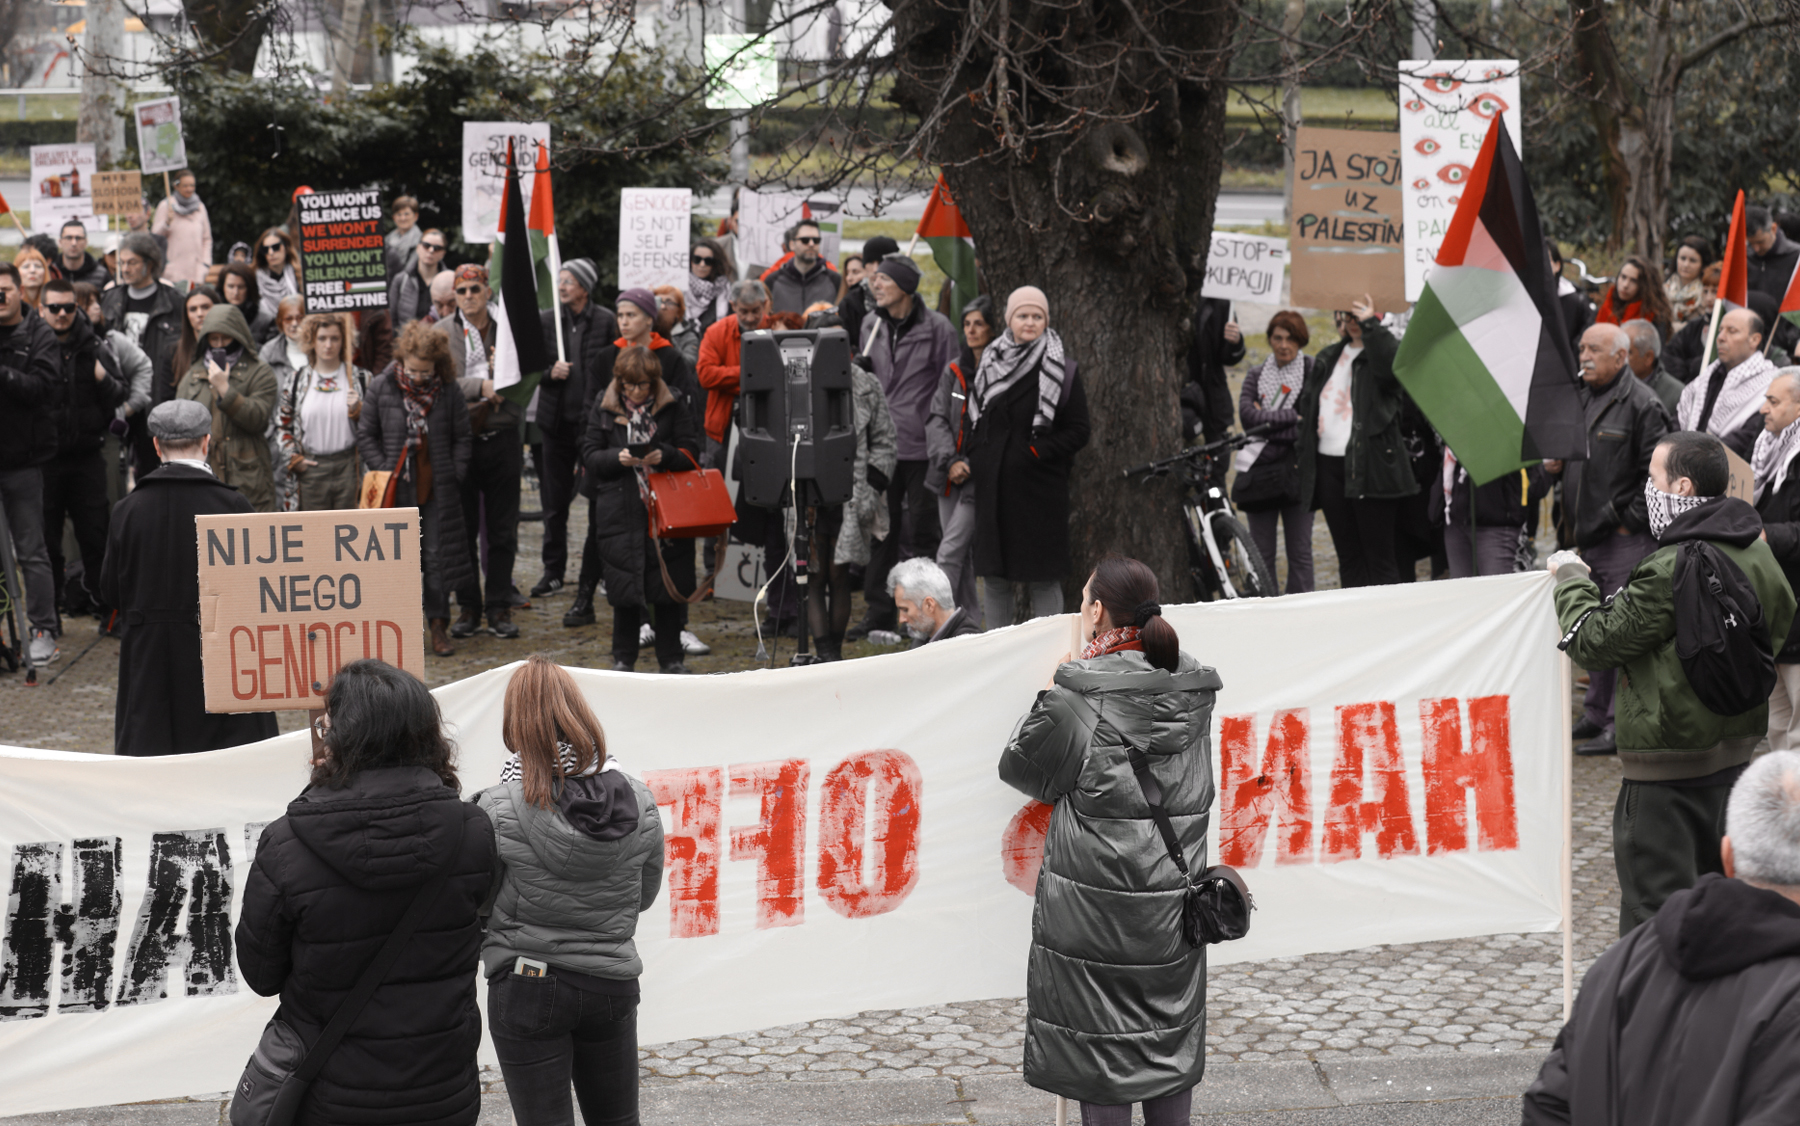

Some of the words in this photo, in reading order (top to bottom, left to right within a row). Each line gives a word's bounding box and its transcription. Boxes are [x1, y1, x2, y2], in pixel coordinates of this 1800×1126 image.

[1300, 150, 1337, 180] JA
[300, 194, 330, 209] YOU
[331, 191, 379, 207] WON'T
[623, 194, 690, 212] GENOCIDE
[301, 207, 360, 224] SILENCE
[361, 206, 381, 219] US
[630, 216, 646, 231] IS
[651, 216, 686, 232] NOT
[302, 224, 327, 238] WE
[328, 221, 378, 236] WON'T
[1297, 213, 1404, 243] PALESTIN
[303, 235, 384, 252] SURRENDER
[634, 234, 674, 250] SELF
[1213, 238, 1269, 262] STOP
[304, 252, 334, 266] YOU
[336, 249, 384, 264] WON'T
[622, 252, 689, 270] DEFENSE
[306, 265, 365, 281] SILENCE
[366, 264, 386, 277] US
[1206, 266, 1273, 295] KUPACIJI
[306, 281, 345, 296] FREE
[307, 292, 388, 310] PALESTINE
[207, 525, 304, 566] NIJE
[334, 522, 409, 561] RAT
[259, 573, 362, 613] NEGO
[229, 620, 403, 701] GENOCID
